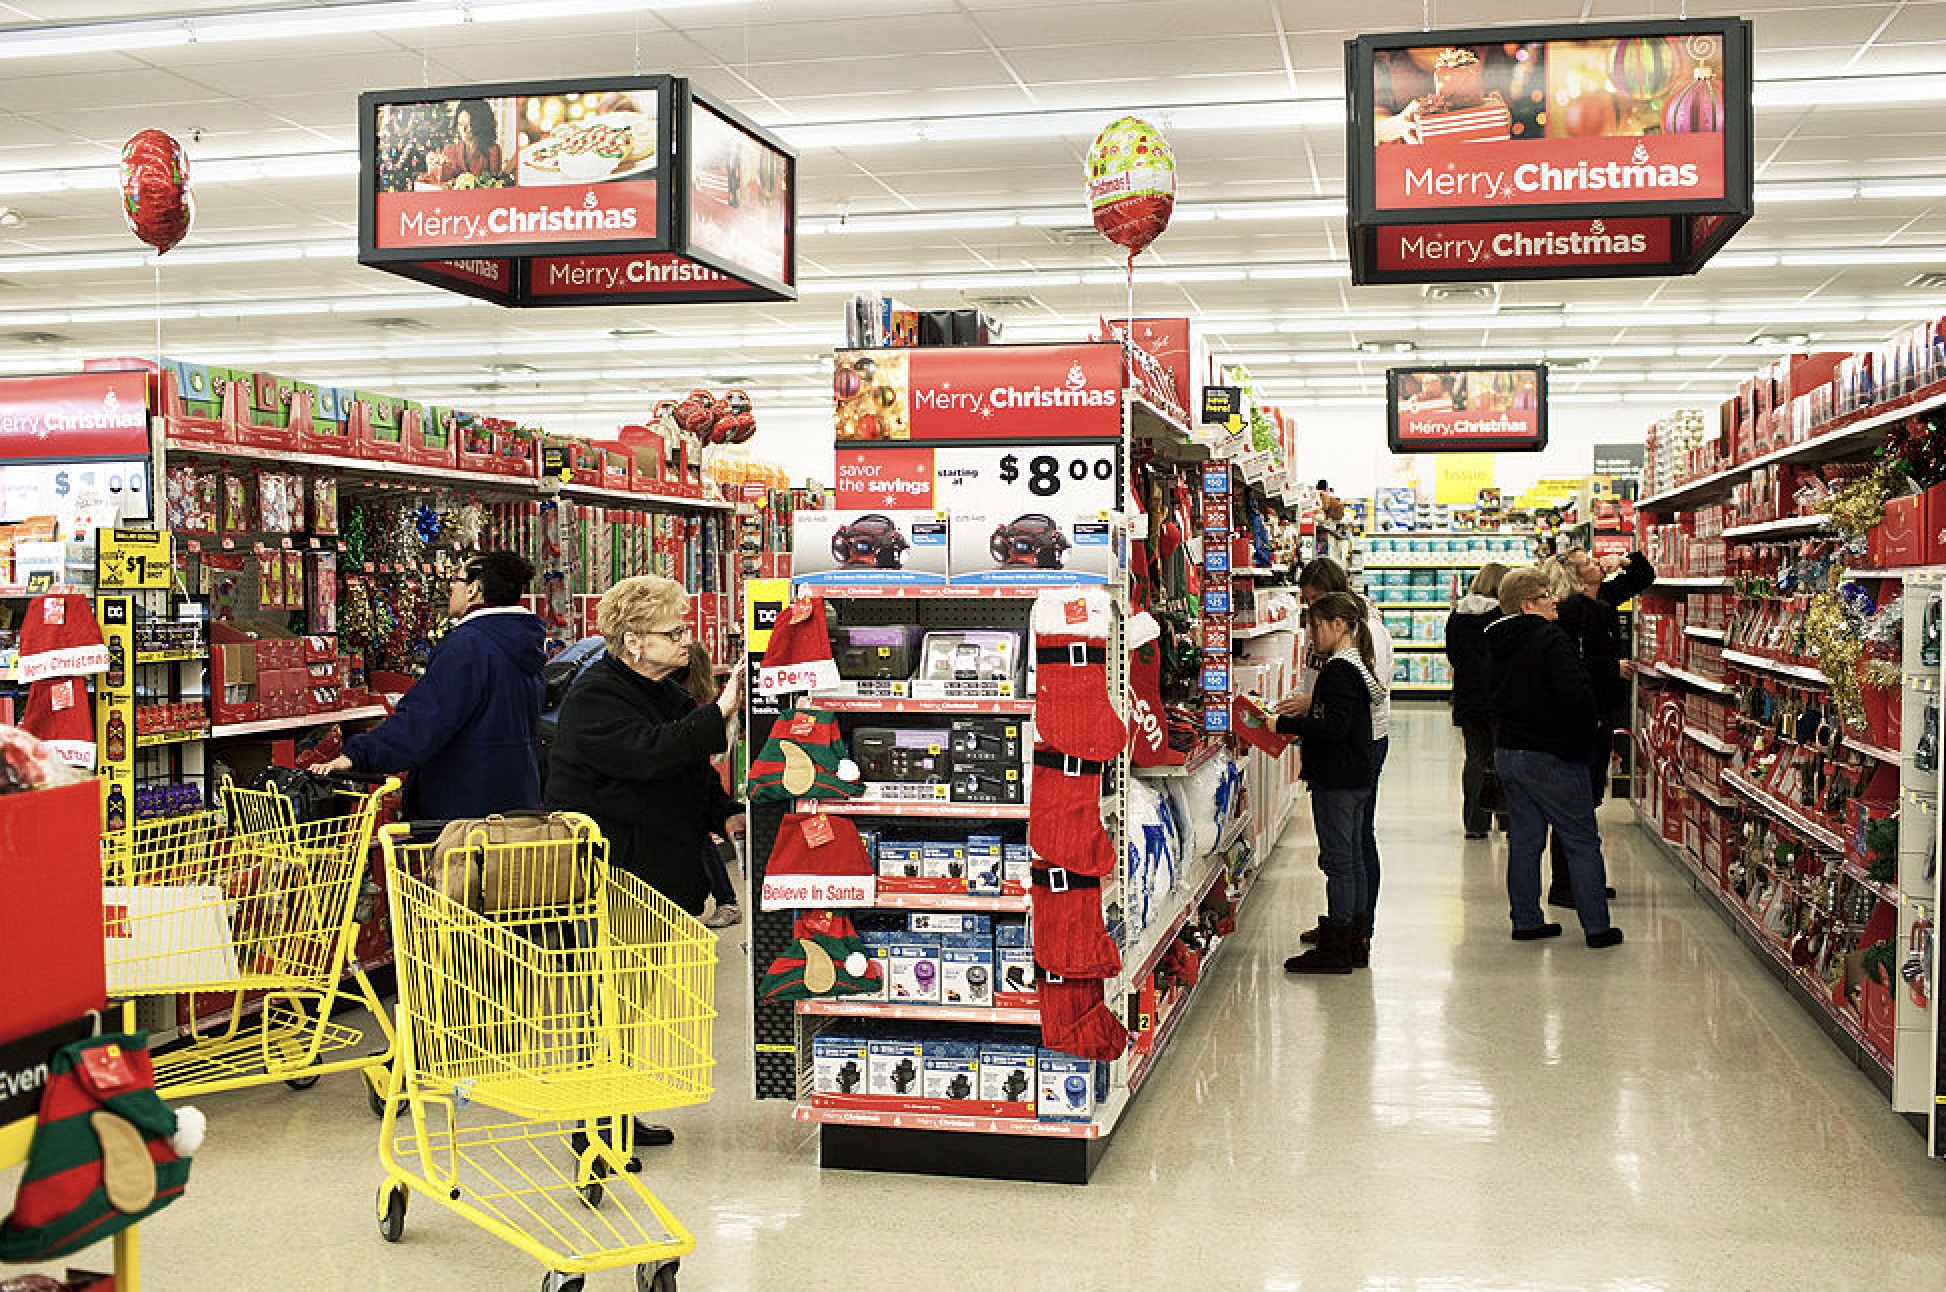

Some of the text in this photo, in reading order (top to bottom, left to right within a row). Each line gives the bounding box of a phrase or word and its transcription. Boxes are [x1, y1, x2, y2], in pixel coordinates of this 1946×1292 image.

[1404, 161, 1698, 198] Merry Christmas
[400, 204, 637, 238] Merry Christmas
[1400, 232, 1647, 263] Merry Christmas
[549, 262, 618, 289] Merry
[915, 386, 1117, 413] Merry Christmas
[0, 411, 143, 437] erry Christmas
[1409, 418, 1527, 436] Merry Christmas
[839, 464, 882, 477] savor
[937, 467, 979, 479] starting
[839, 478, 931, 494] the savings
[125, 556, 146, 584] $1
[763, 883, 808, 901] Believe
[826, 884, 865, 901] Santa
